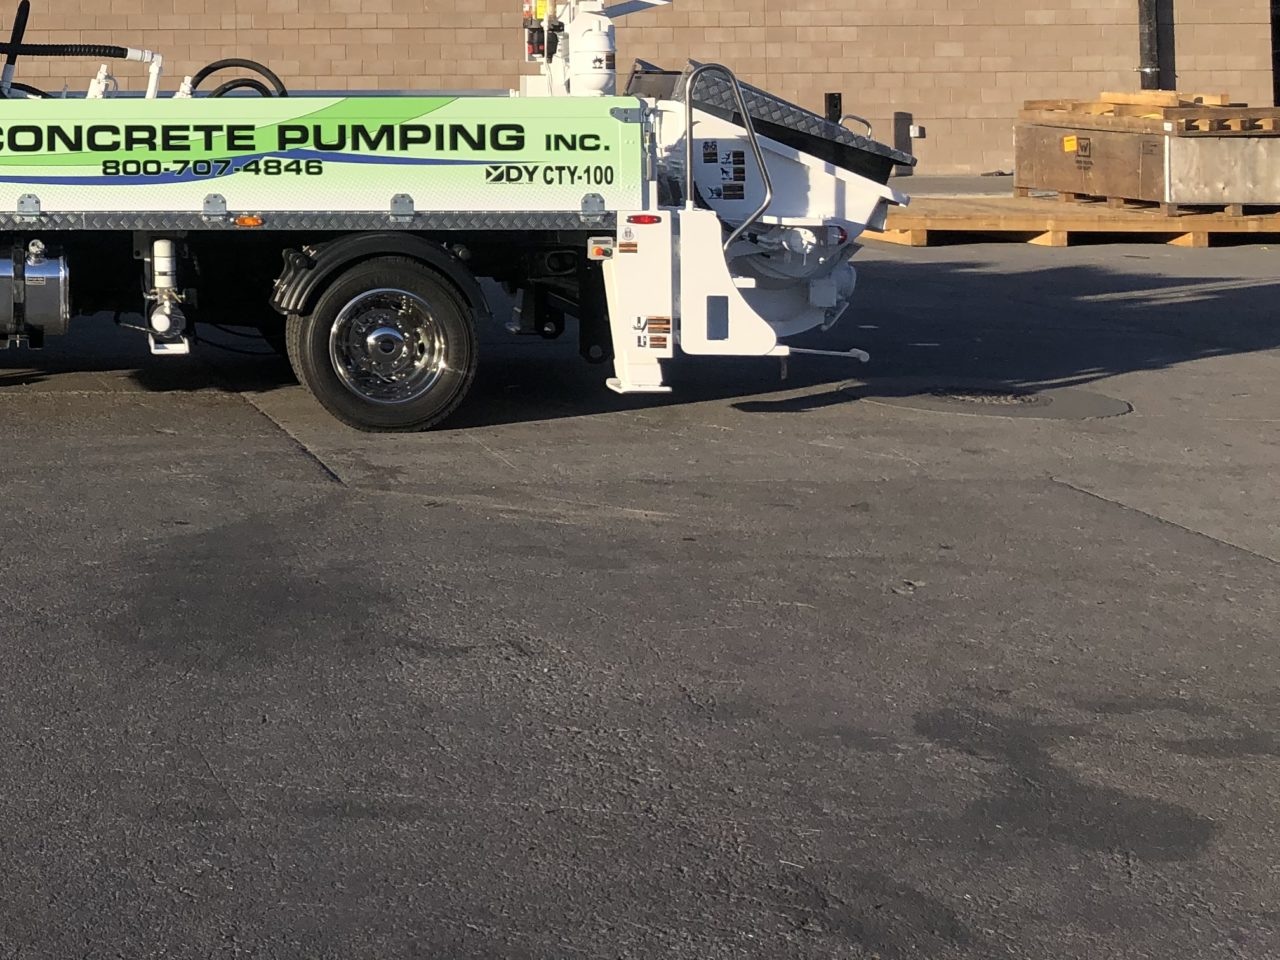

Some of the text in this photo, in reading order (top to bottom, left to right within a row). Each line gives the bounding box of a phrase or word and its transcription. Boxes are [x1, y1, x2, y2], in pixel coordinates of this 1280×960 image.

[277, 123, 526, 152] PUMPING
[545, 133, 610, 152] INC.
[101, 159, 324, 176] 800-707-4846
[542, 165, 614, 185] CTY-100
